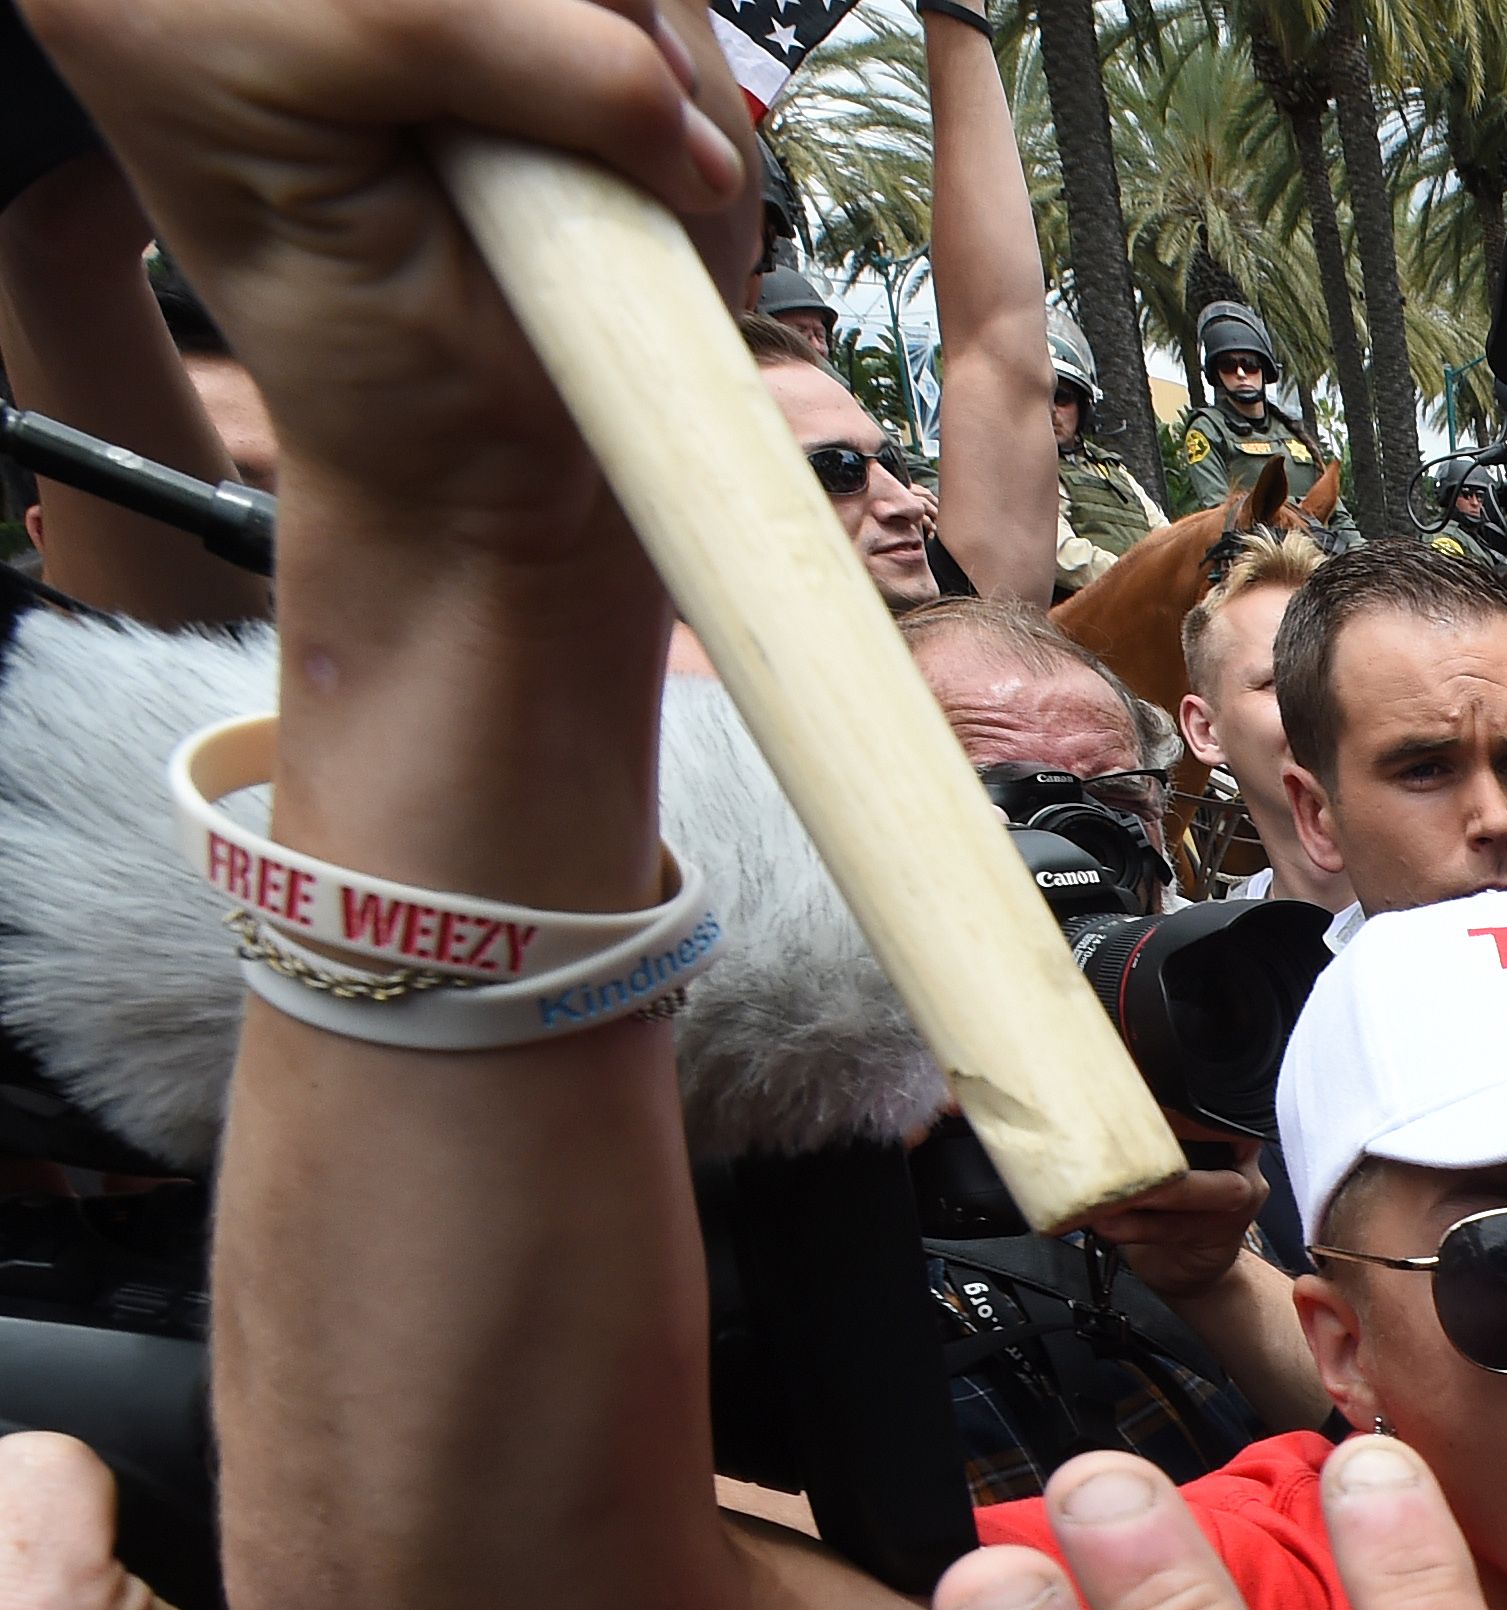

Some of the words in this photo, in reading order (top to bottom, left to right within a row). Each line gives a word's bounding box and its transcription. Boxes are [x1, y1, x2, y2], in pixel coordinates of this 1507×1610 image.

[1036, 773, 1075, 784] Canon
[206, 830, 314, 927] FREE
[340, 885, 540, 975] WEEZY
[1036, 869, 1101, 888] Canon
[538, 911, 724, 1029] Kindness
